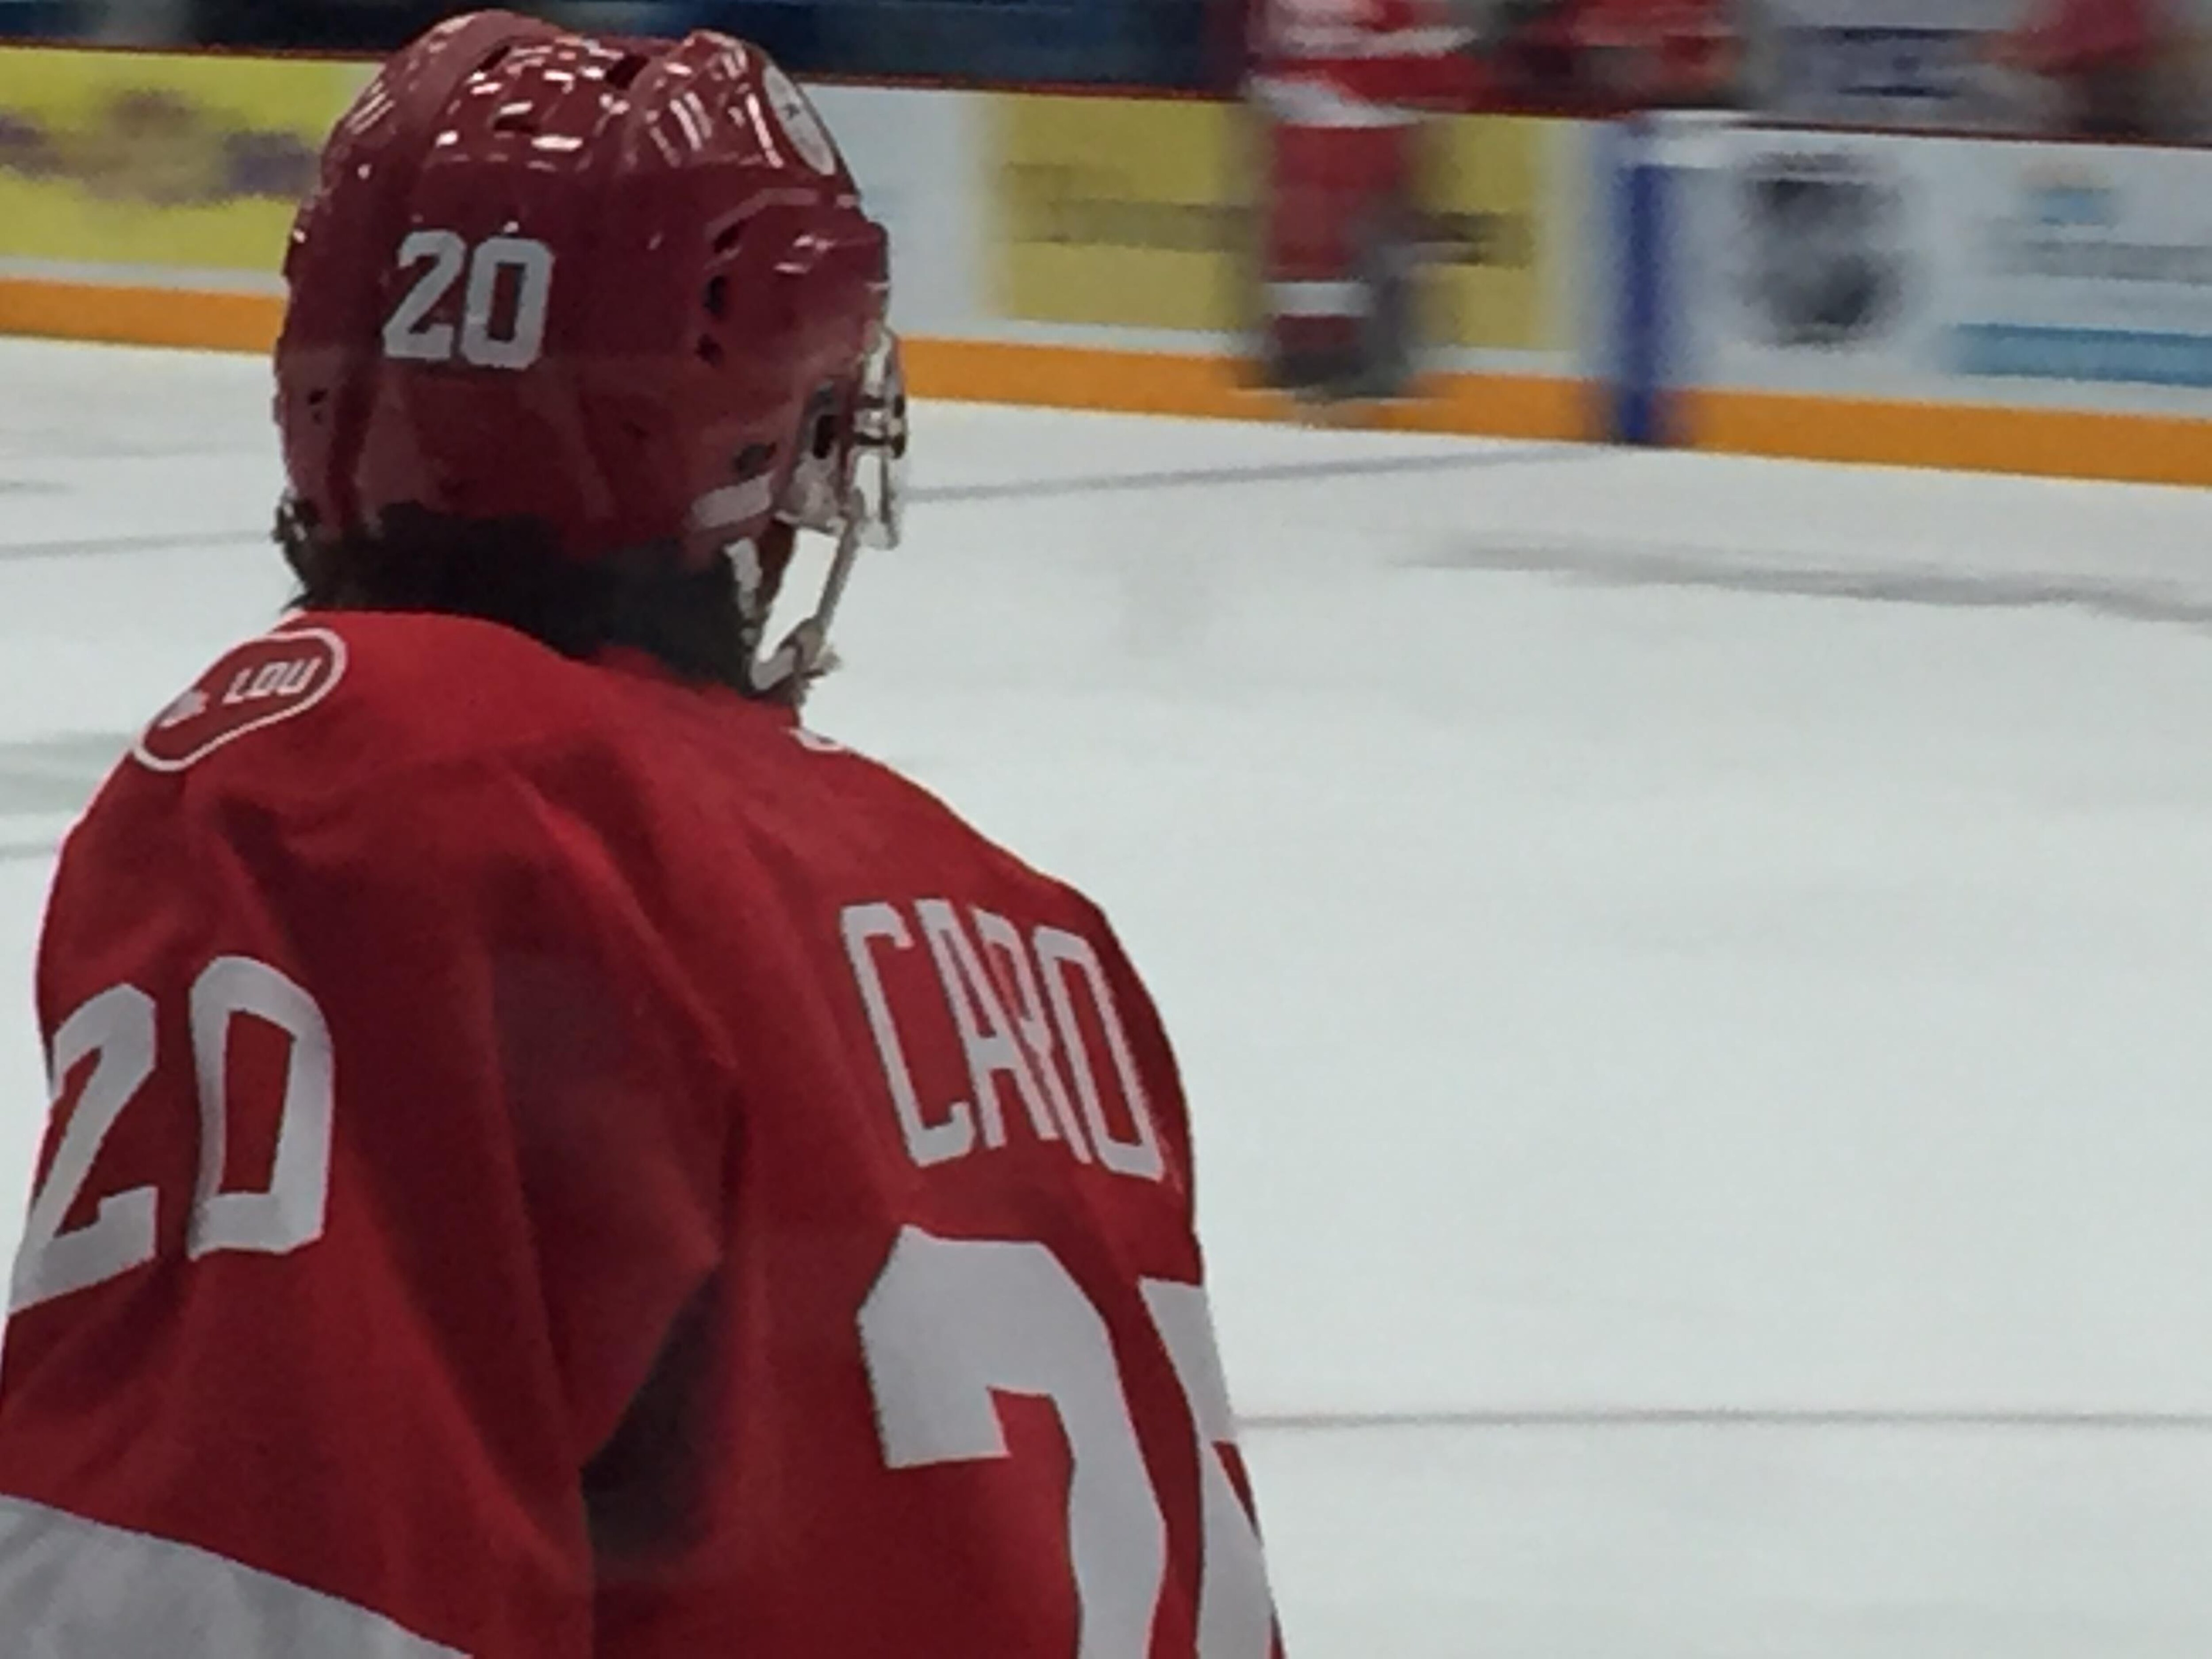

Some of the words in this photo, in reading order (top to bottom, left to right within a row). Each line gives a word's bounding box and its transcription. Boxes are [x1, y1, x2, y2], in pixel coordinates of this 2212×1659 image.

[382, 229, 555, 370] 20
[223, 657, 322, 704] LOU
[7, 955, 335, 1316] 20
[857, 1224, 1274, 1659] 2
